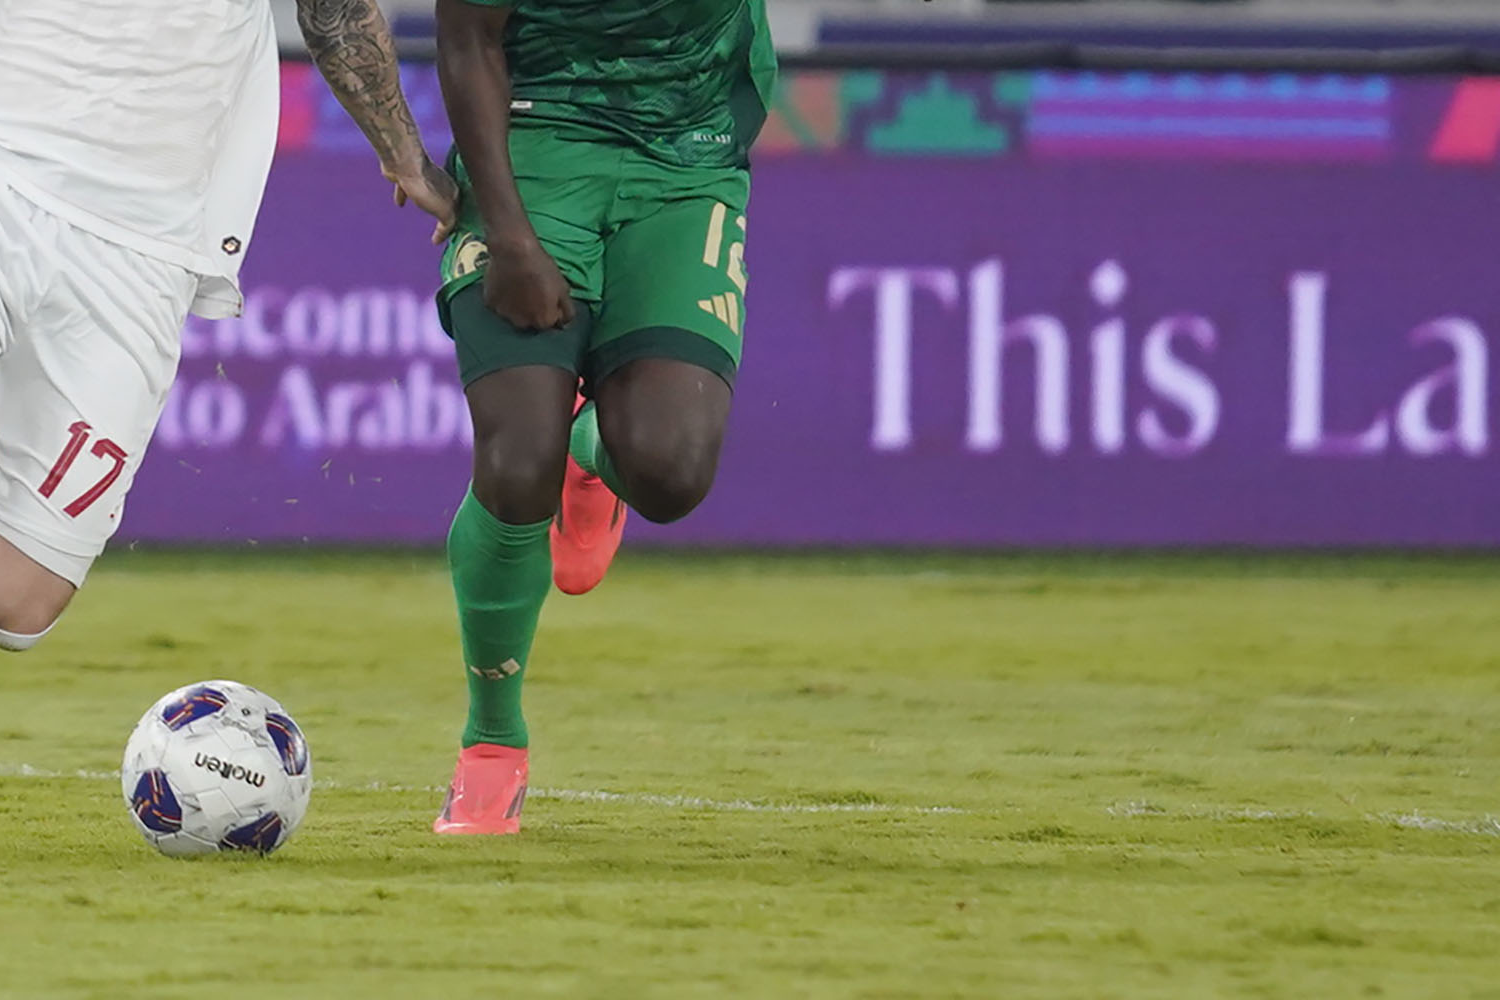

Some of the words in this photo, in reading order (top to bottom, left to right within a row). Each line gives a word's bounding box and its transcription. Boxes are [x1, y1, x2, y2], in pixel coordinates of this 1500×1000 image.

[827, 257, 1221, 456] This
[1286, 270, 1490, 456] La
[258, 361, 475, 447] Arab
[37, 421, 129, 518] 17
[195, 752, 266, 788] molten
